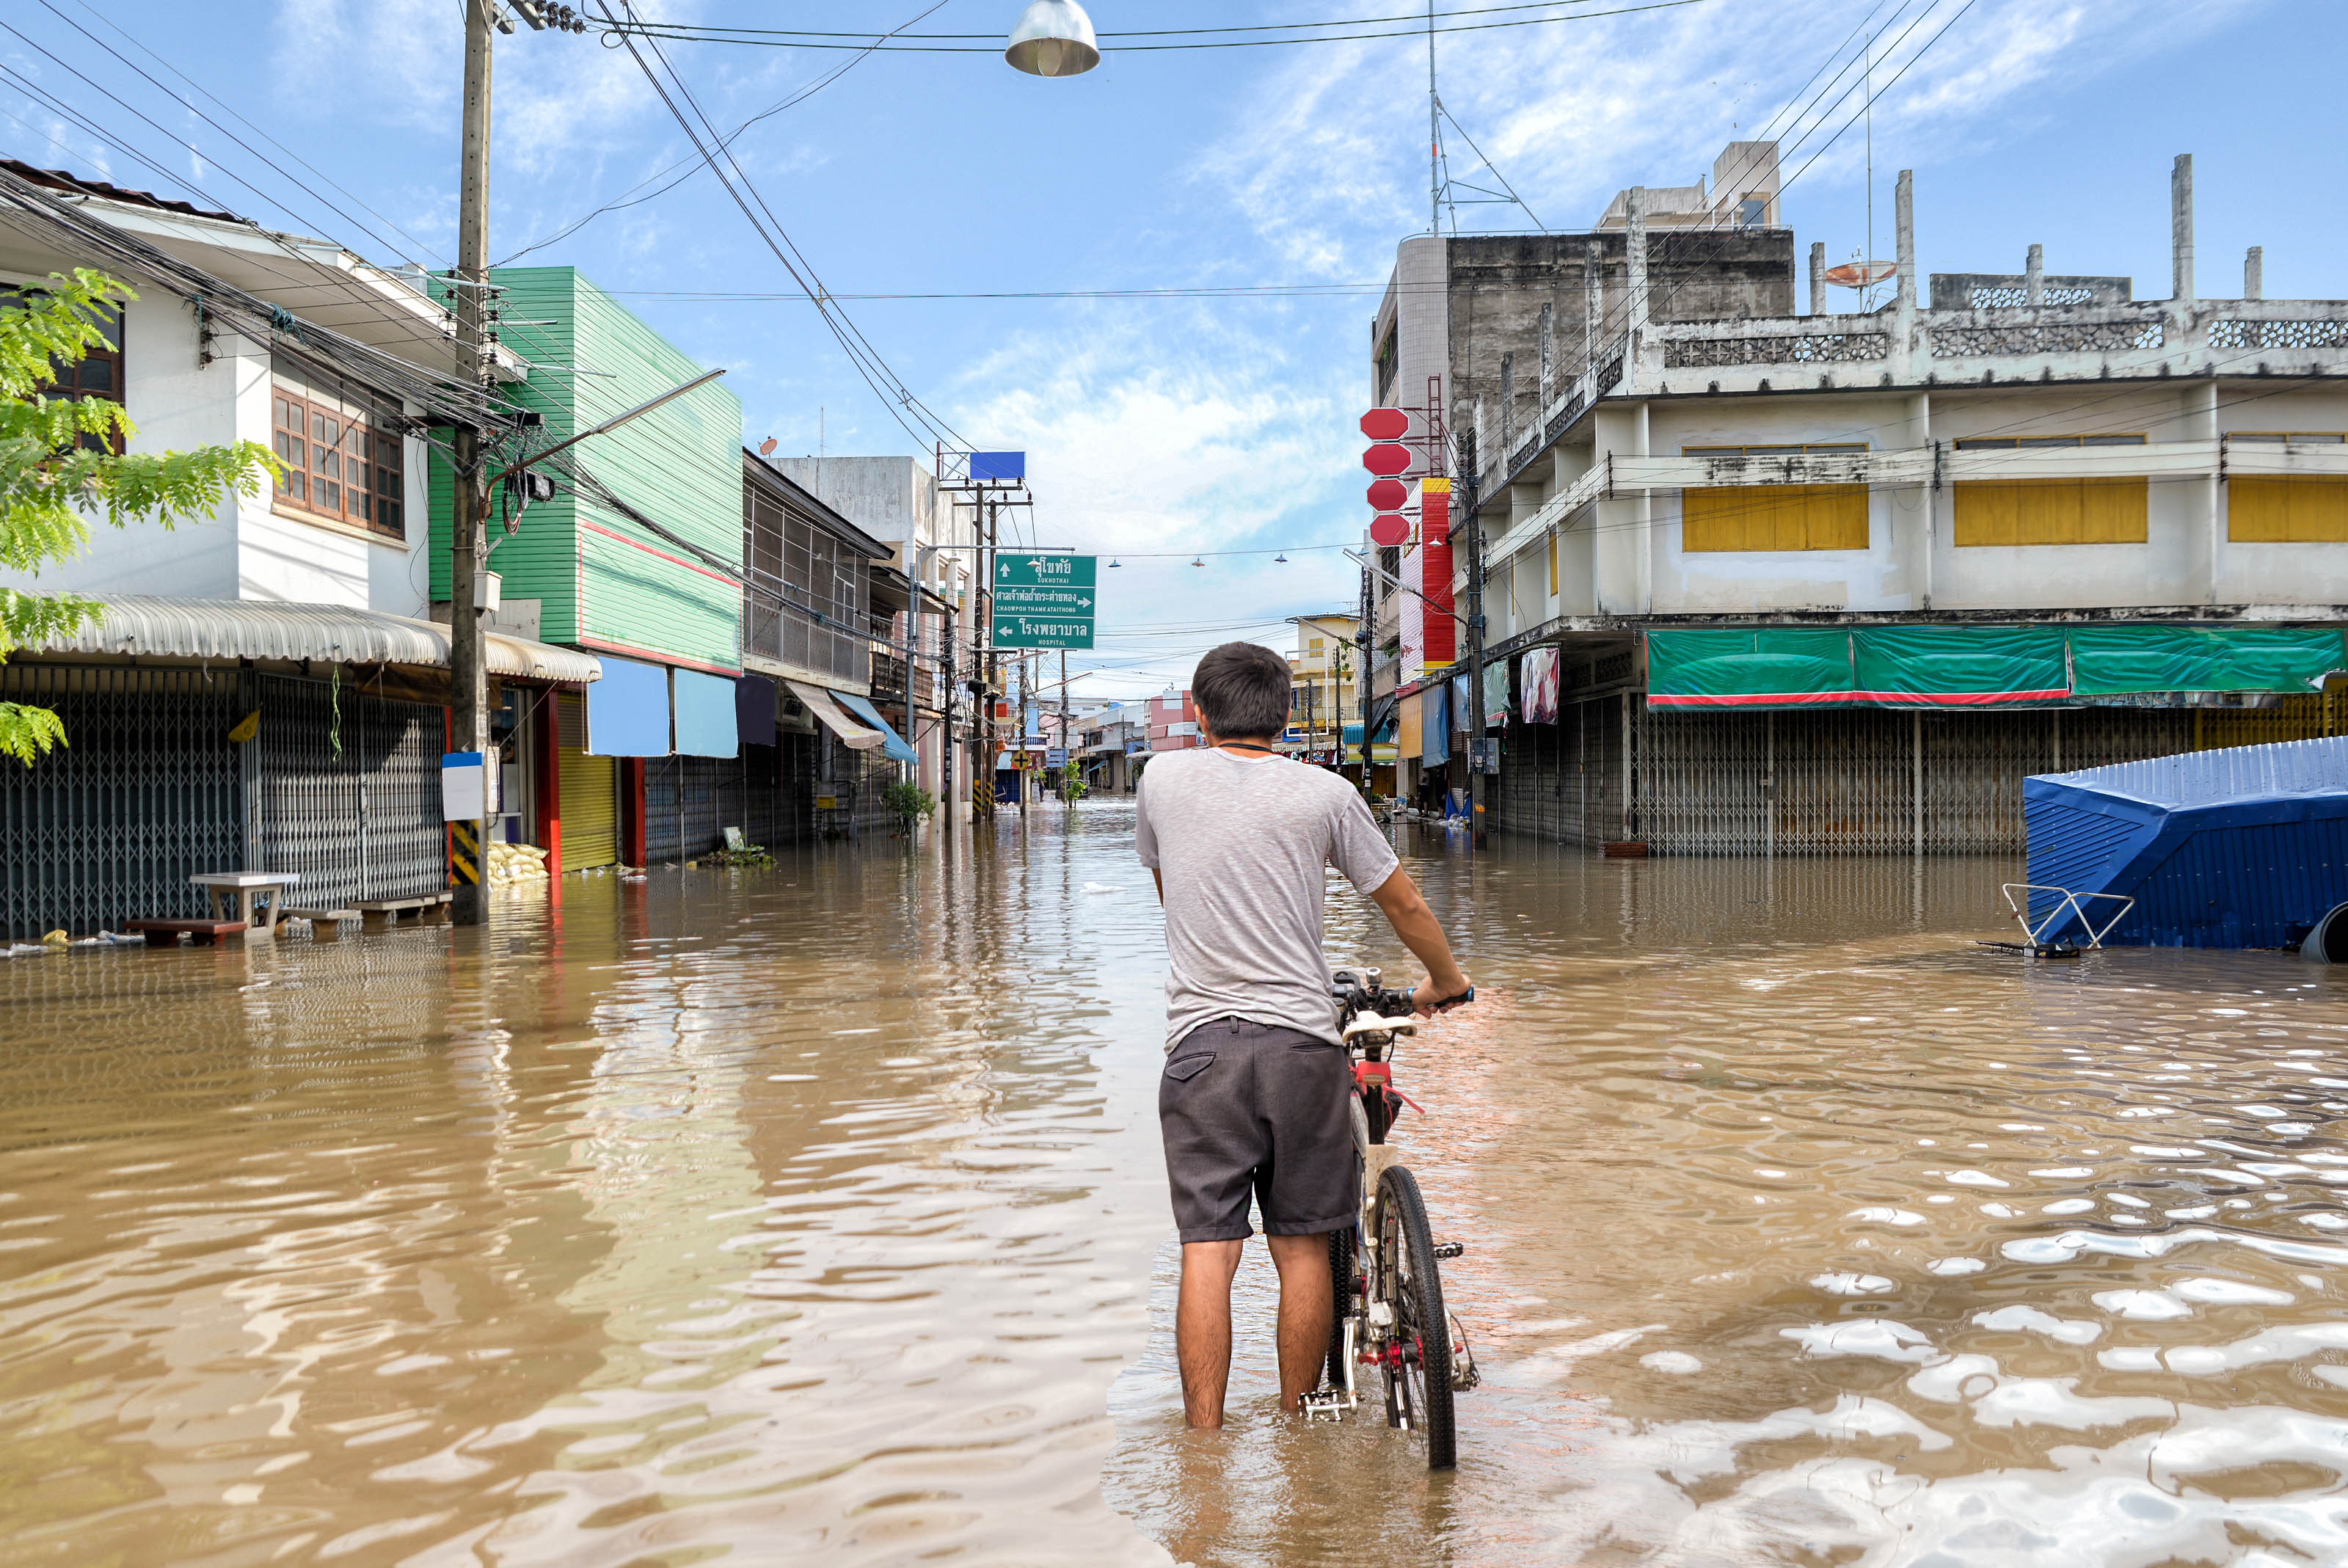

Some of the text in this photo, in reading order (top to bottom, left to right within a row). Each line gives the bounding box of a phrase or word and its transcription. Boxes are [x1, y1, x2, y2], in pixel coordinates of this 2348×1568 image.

[1035, 556, 1071, 577] สุโขทัย
[1018, 618, 1087, 636] โรงพยาบาล
